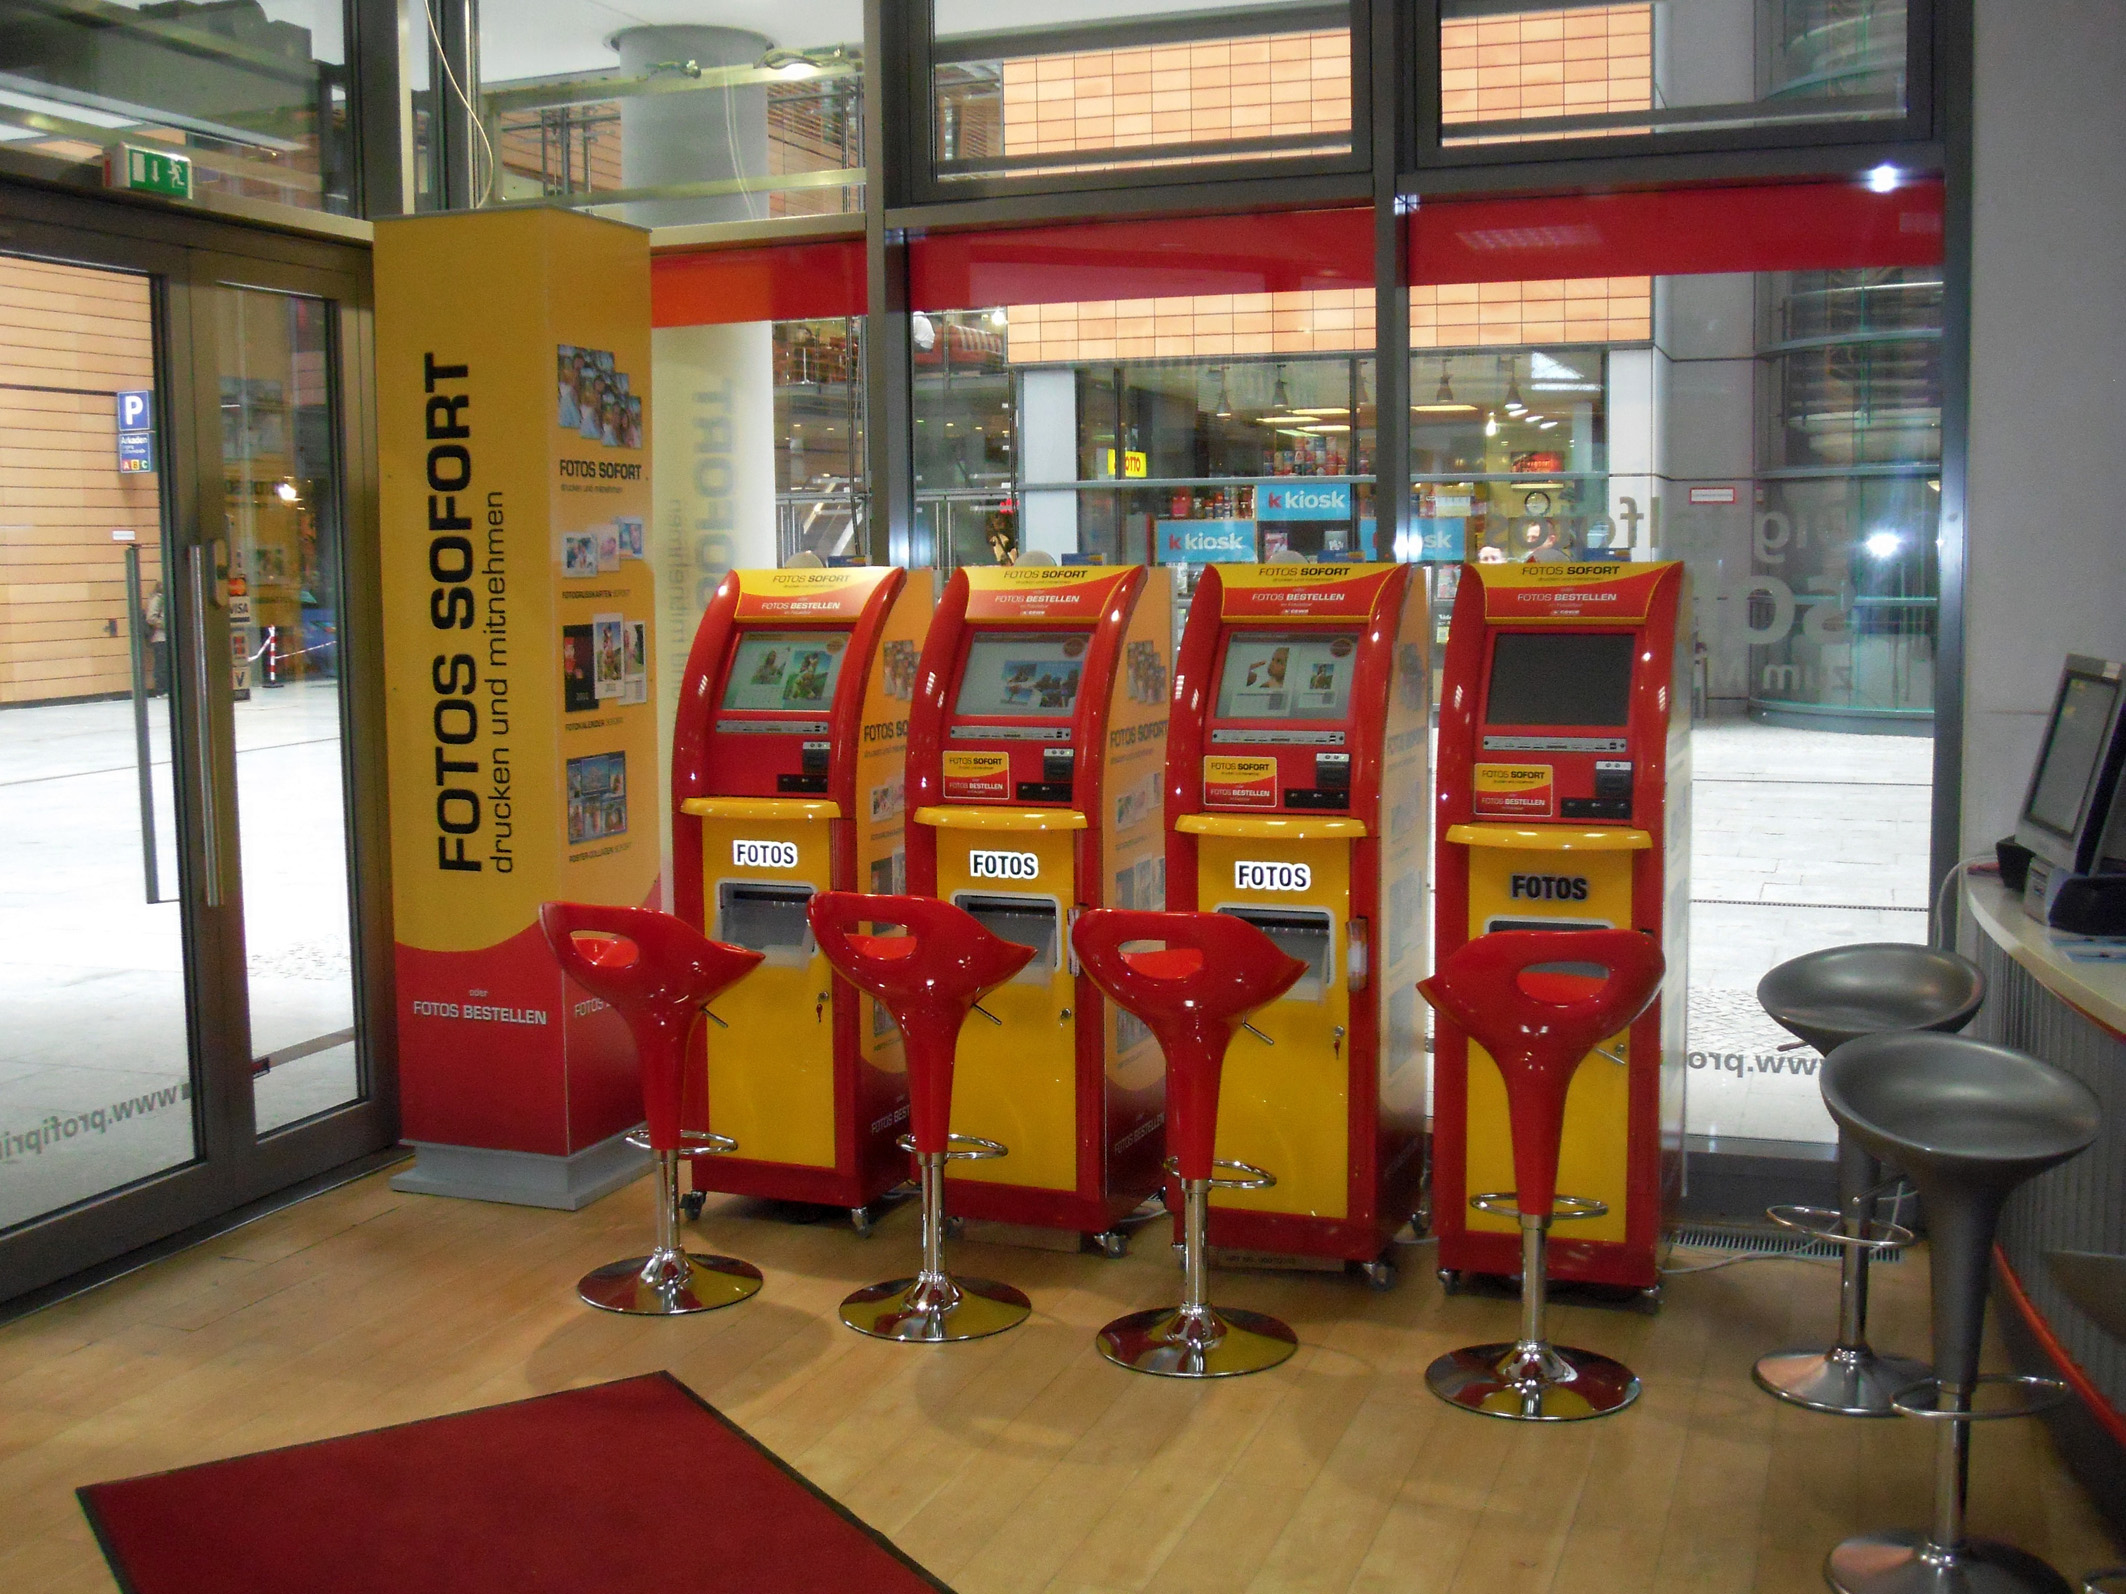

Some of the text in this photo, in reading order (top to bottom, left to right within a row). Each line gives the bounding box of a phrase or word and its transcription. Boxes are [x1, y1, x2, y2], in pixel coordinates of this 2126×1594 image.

[125, 395, 144, 426] P
[559, 459, 642, 480] FOTOS SOFORT
[1285, 490, 1345, 509] kiosk
[1184, 532, 1244, 551] kiosk
[772, 574, 850, 583] FOTOS SOFORT
[1003, 570, 1088, 579] FOTOS SOFORT
[1258, 567, 1351, 576] FOTOS SOFORT
[1521, 566, 1620, 575] FOTOS SOFORT
[761, 602, 841, 610] FOTOS BESTELLEN
[994, 595, 1080, 603] FOTOS BESTELLEN
[1251, 593, 1345, 601] FOTOS BESTELLEN
[1517, 593, 1617, 602] FOTOS BESTELLEN
[424, 352, 482, 872] FOTOS SOFORT
[482, 490, 513, 874] drucken und mitnehmen
[864, 721, 894, 742] FOTOS
[1110, 720, 1169, 748] FOTOS SOFORT
[949, 757, 1003, 765] FOTOS SOFORT
[1211, 762, 1270, 771] FOTOS SOFORT
[1482, 770, 1545, 779] FOTOS SOFORT
[1504, 798, 1545, 806] BESTELLEN
[736, 843, 795, 864] FOTOS
[973, 854, 1036, 876] FOTOS
[1238, 864, 1307, 888] FOTOS
[1511, 875, 1588, 900] FOTOS
[469, 988, 489, 998] oder
[413, 1000, 547, 1025] FOTOS BESTELLEN
[574, 997, 604, 1018] FOTOS
[871, 1112, 893, 1137] FOTOS
